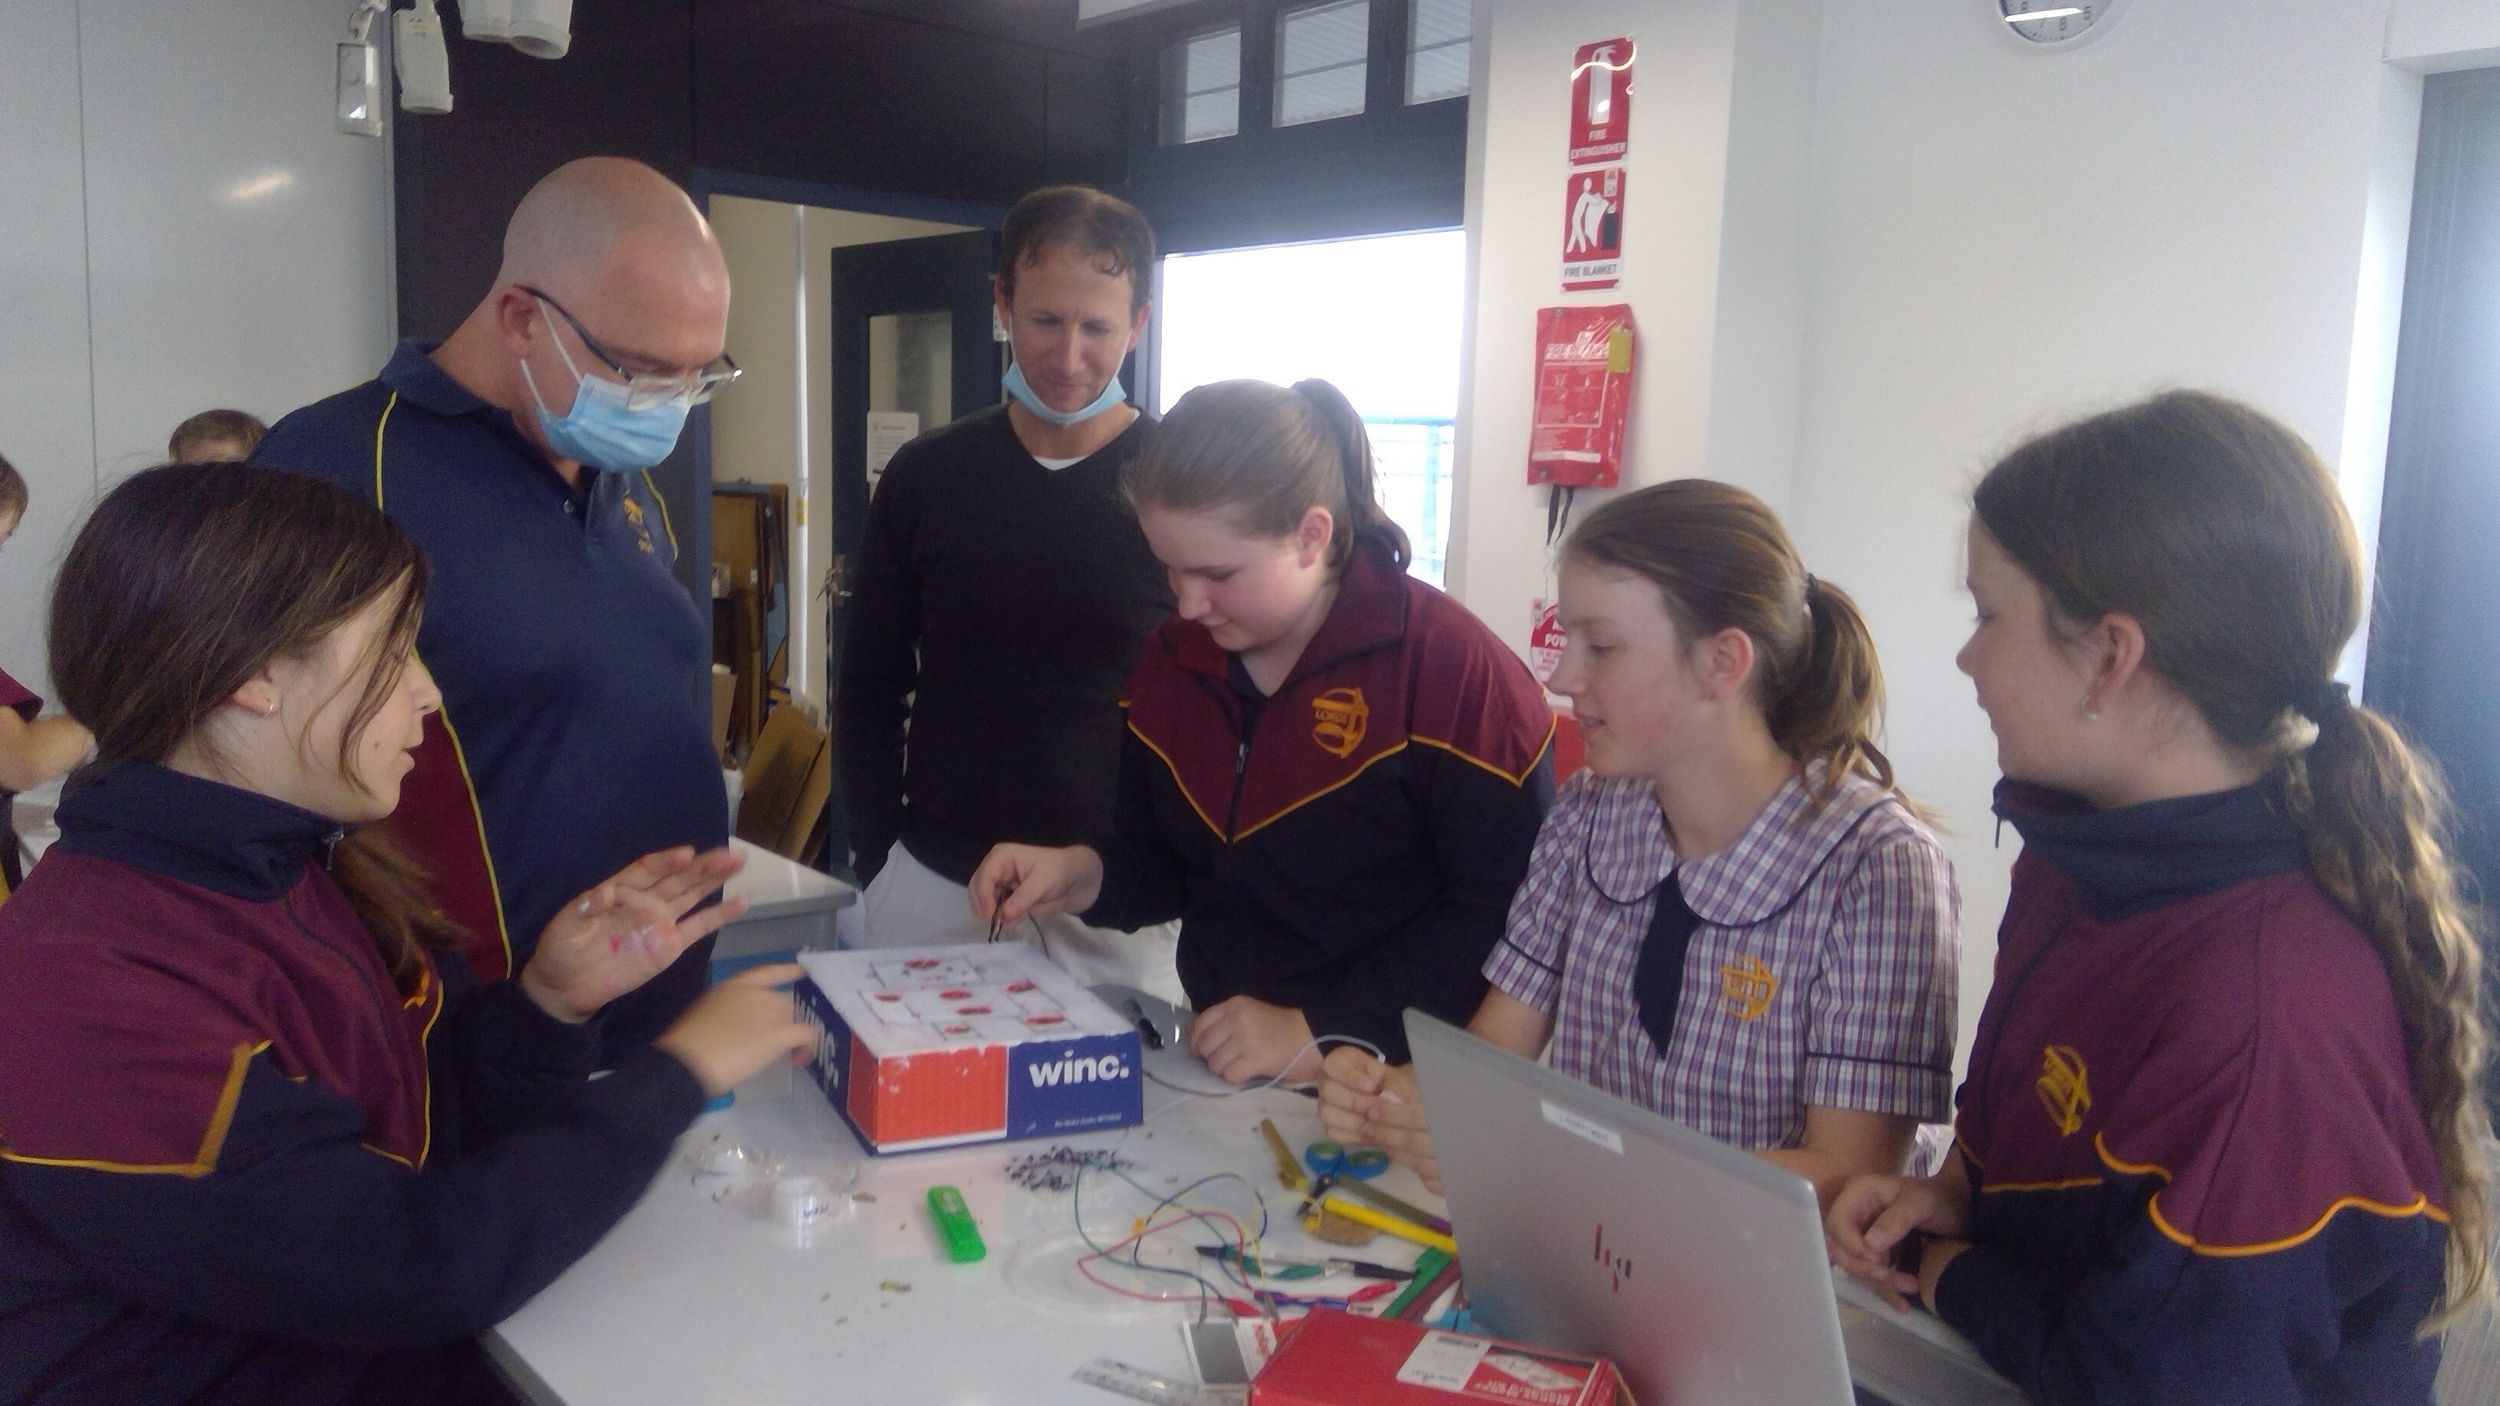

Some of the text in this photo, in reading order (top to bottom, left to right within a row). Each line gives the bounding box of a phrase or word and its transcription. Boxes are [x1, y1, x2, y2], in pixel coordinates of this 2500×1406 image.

[1588, 129, 1607, 142] FIRE
[1564, 263, 1617, 278] FIRE BLANKET
[1028, 1049, 1130, 1089] winc.
